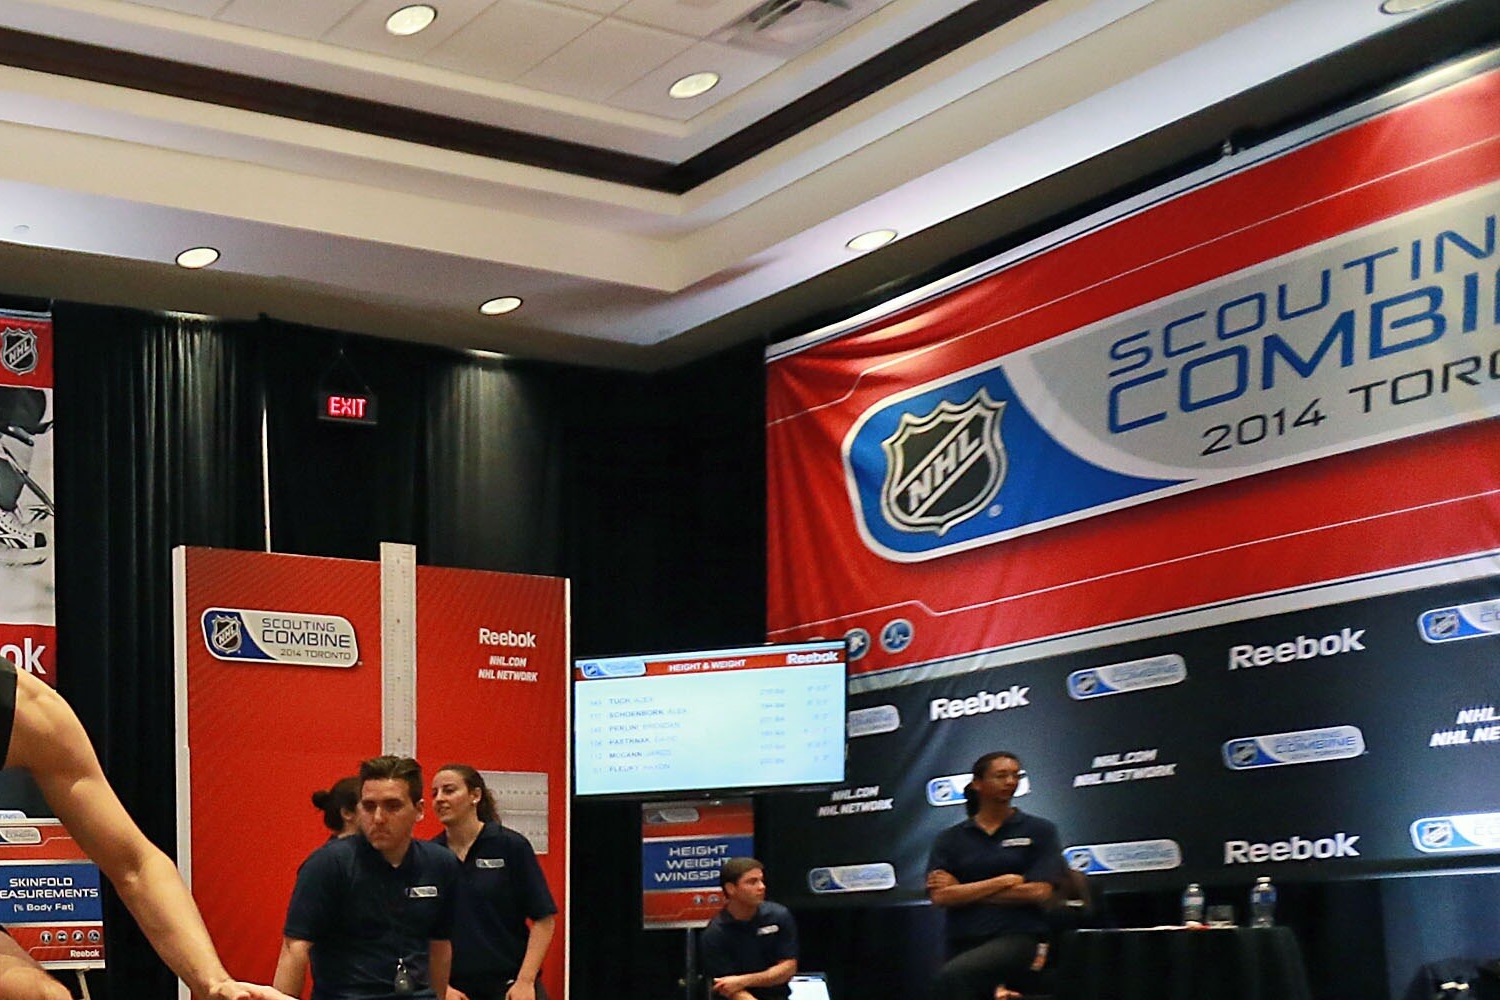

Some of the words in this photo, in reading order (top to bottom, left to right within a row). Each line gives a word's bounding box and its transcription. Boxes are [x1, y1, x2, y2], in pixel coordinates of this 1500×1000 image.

[1108, 214, 1497, 378] SCOUTIN
[8, 341, 32, 363] NHL
[1108, 266, 1500, 434] COMBI
[329, 396, 366, 417] EXIT
[1200, 398, 1327, 457] 2014
[907, 425, 981, 514] NHL
[262, 618, 335, 632] SCOUTING
[262, 630, 350, 648] COMBINE
[479, 627, 536, 649] Reebok
[280, 648, 302, 657] 2014
[305, 650, 351, 660] TORONTO
[1228, 627, 1366, 671] Reebok
[489, 655, 527, 668] NHL.COM
[669, 662, 701, 672] HEIGHT
[711, 659, 747, 669] WEIGHT
[786, 651, 839, 665] Reebok
[478, 668, 496, 679] NHL
[497, 669, 538, 682] NETWORK
[930, 685, 1030, 722] Reebok
[1429, 730, 1471, 747] NHL
[669, 845, 729, 857] HEIGHT
[1224, 833, 1360, 864] Reebok
[666, 857, 732, 869] WEIGHT
[9, 877, 73, 888] SKINFOLD
[655, 870, 721, 882] WINGSP
[27, 903, 51, 913] Body
[55, 903, 74, 912] Fat)
[70, 949, 100, 958] Reebok
